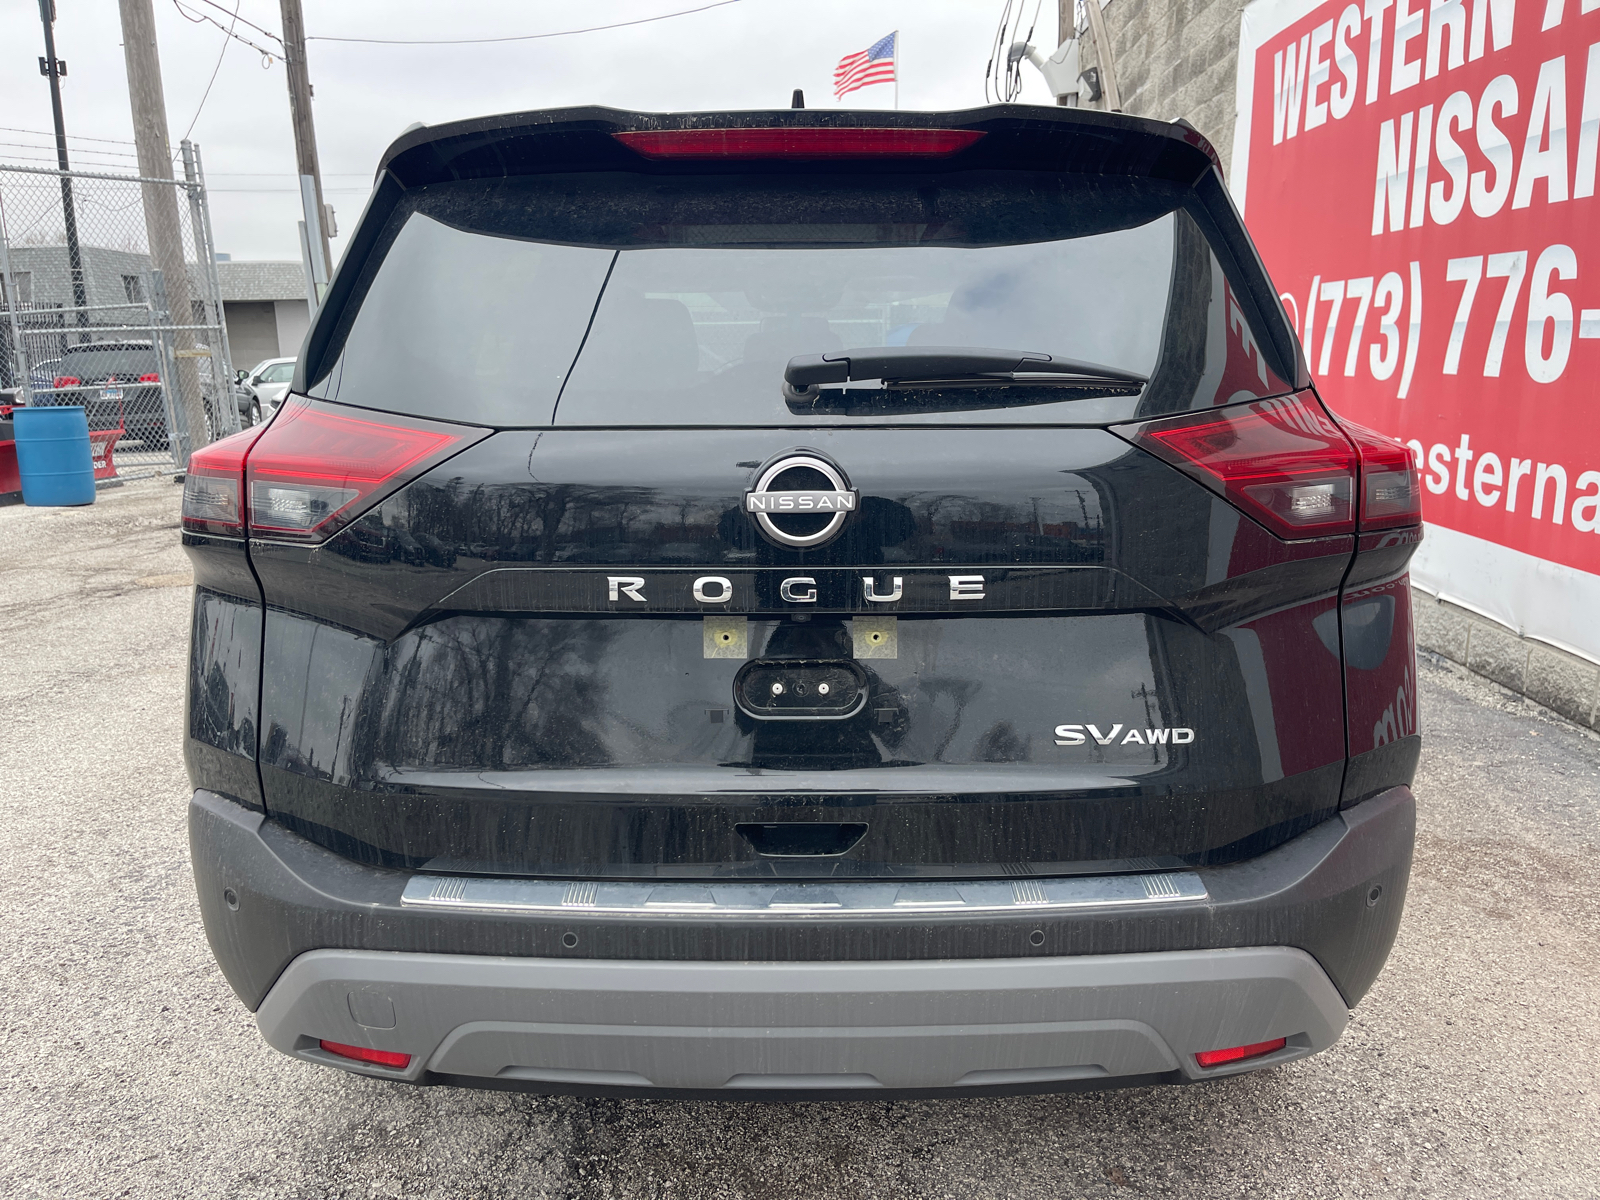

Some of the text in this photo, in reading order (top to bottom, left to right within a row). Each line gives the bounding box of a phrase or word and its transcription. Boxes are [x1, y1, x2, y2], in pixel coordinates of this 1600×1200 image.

[1304, 261, 1423, 399] (773)
[750, 495, 854, 511] NISSAN
[606, 575, 987, 604] ROGUE
